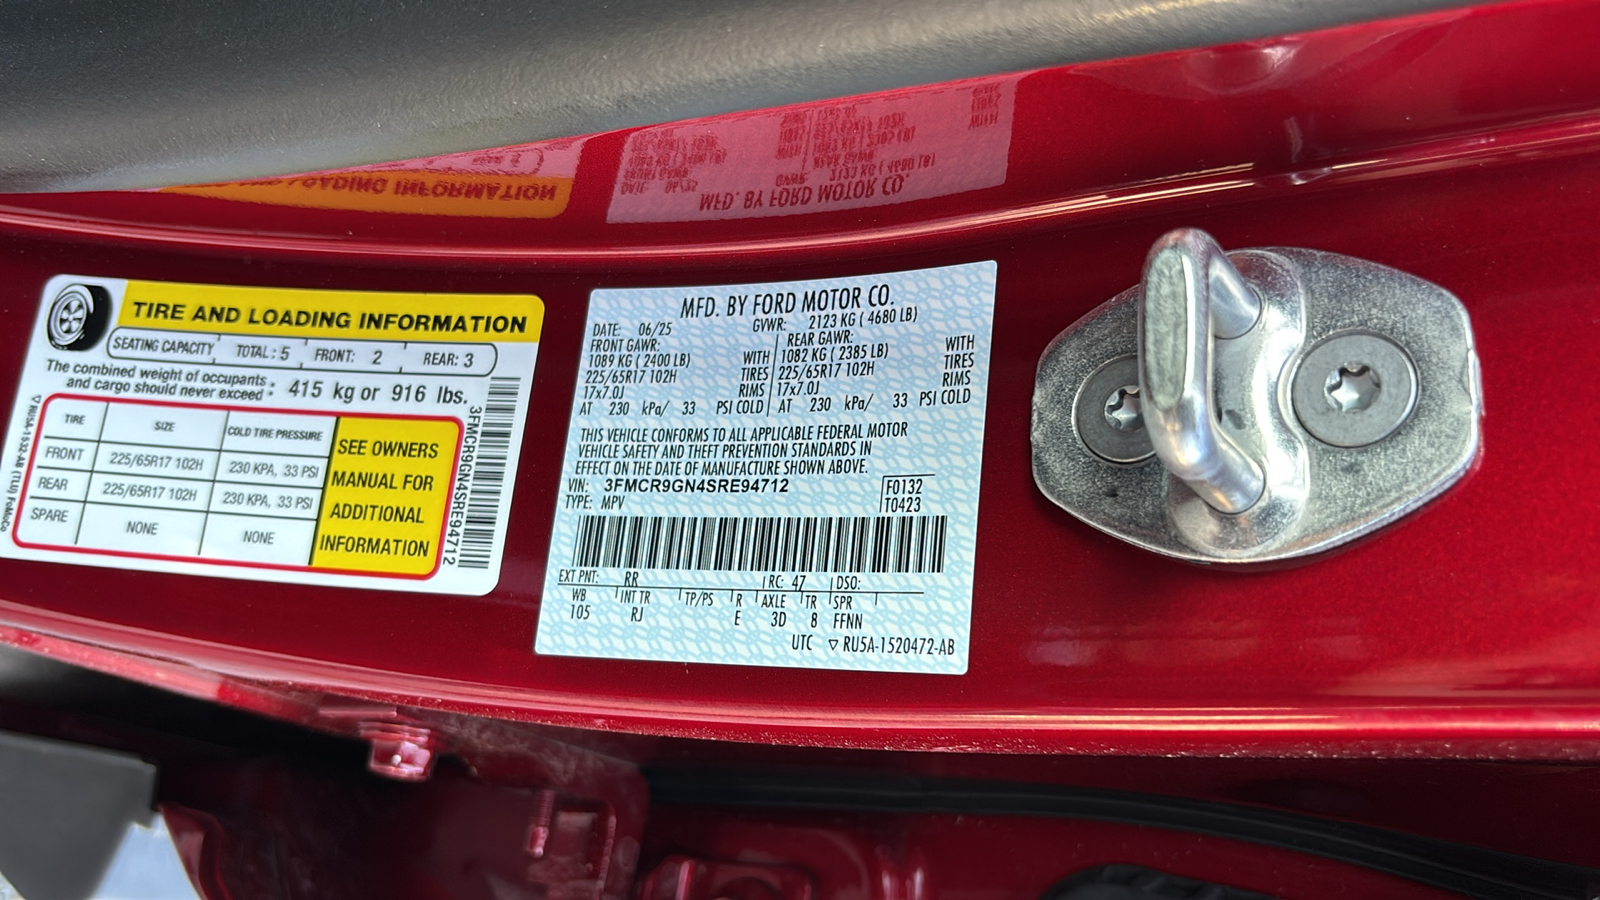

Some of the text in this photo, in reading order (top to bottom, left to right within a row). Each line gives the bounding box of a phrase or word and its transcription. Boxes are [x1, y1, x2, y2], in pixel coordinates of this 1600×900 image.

[680, 284, 895, 318] MFD. BY FORD MOTOR CO.
[133, 301, 527, 333] TIRE AND LOADING INFORMATION
[752, 308, 896, 333] GVWR: 2123 KG 4680
[592, 321, 673, 337] DATE: 06/25
[112, 336, 215, 356] SEATING CAPACITY
[590, 338, 661, 353] FRONT GAWR:
[787, 331, 854, 347] REAR GAWR:
[945, 334, 975, 351] WITH
[279, 346, 291, 361] 5
[314, 348, 383, 365] FRONT: 2
[423, 352, 474, 368] REAR: 3
[588, 353, 671, 368] 1089 KG 2400
[743, 350, 770, 365] WITH
[781, 344, 867, 363] 1082 KG 2385
[944, 352, 975, 369] TIRES
[46, 358, 268, 390] The combined weight of occupants
[585, 369, 677, 386] 225/65R17 102H
[741, 366, 769, 382] TIRES
[777, 361, 875, 382] 225/65R17 102H
[941, 370, 971, 387] RIMS
[66, 376, 264, 401] and cargo should never exceed
[288, 380, 469, 405] 415 kg or 916 lbs.
[583, 385, 625, 400] 17x7.0J
[738, 383, 765, 398] RIMS
[776, 380, 820, 397] 17x7.0J
[579, 399, 764, 416] AT 230 kPa/ 33 PSI COLD
[778, 387, 971, 414] AT 230 kPa/ 33 PSI COLD
[65, 413, 86, 426] TIRE
[154, 421, 176, 433] SIZE
[228, 426, 324, 442] COLD TIRE PRESSURE
[580, 421, 908, 443] THIS VEHICLE CONFORMS ALL APPLICABLE FEDERAL MOTOR
[337, 438, 440, 460] SEE OWNERS
[578, 441, 857, 459] VEHICLE SAFETY AND THEFT PREVENTION STANDARDS
[45, 446, 319, 479] FRONT 225/65R17 102H 230 KPA, 33 PSI
[575, 458, 868, 476] EFFECT ON THE DATE OF MANUFACTURE SHOWN ABOVE.
[6, 470, 22, 494] (TLU)
[331, 470, 435, 492] MANUAL FOR
[442, 405, 483, 566] 3FMCR9GN4SRE94712
[568, 478, 789, 493] VIN: 3FMCR9GN4SRE94712
[886, 478, 923, 495] F0132
[38, 477, 314, 511] REAR 225/65R17 102H 230 KPA, 33 PSI
[565, 495, 626, 510] TYPE: MPV
[330, 502, 425, 524] ADDITIONAL
[884, 496, 922, 513] T0423
[0, 496, 16, 532] FoMoCo
[30, 507, 276, 546] SPARE NONE NONE
[319, 534, 431, 558] INFORMATION
[558, 569, 599, 585] EXT PNT:
[768, 574, 784, 589] RC:
[836, 575, 861, 590] DSO:
[572, 587, 587, 602] WB
[685, 591, 714, 607] TP/PS
[761, 594, 787, 609] AXLE
[833, 595, 853, 610] SPR
[570, 604, 591, 620] 105
[630, 606, 644, 622] RJ
[770, 611, 787, 627] 3D
[833, 612, 864, 630] FFNN
[791, 634, 955, 655] UTC RU5A-1520472-AB
